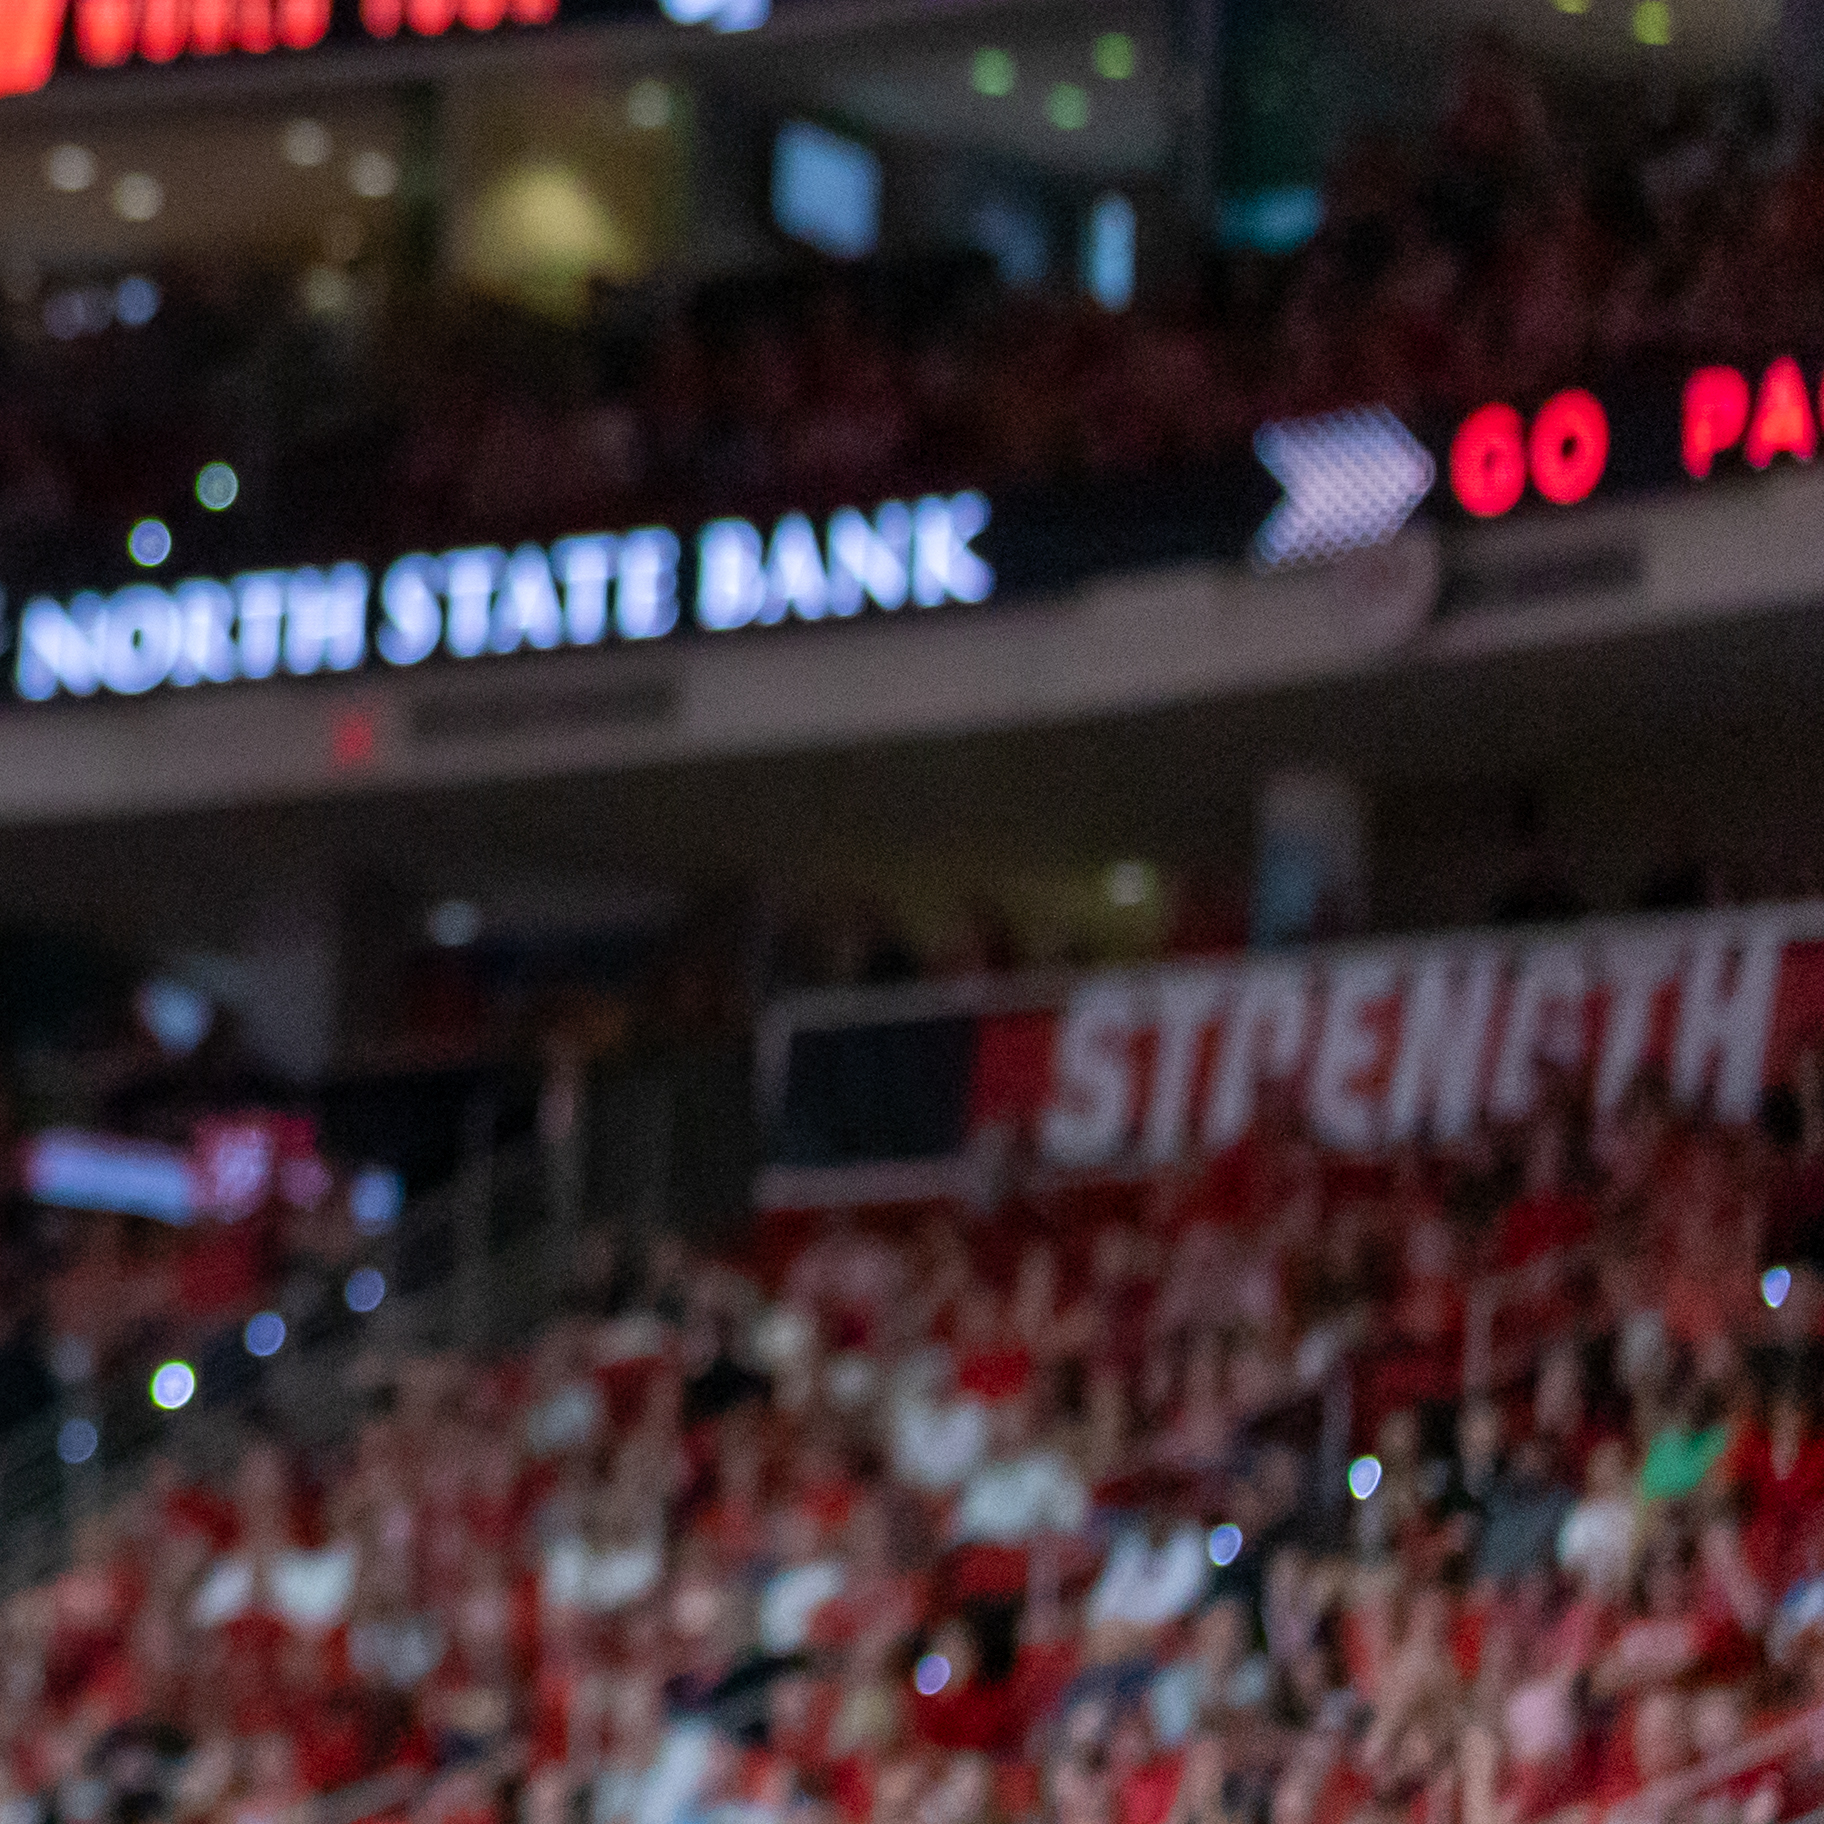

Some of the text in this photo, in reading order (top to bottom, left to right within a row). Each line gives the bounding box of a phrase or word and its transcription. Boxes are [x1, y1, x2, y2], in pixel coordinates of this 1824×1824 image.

[1682, 355, 1824, 479] PA
[16, 490, 994, 701] NORTH STATE BANK
